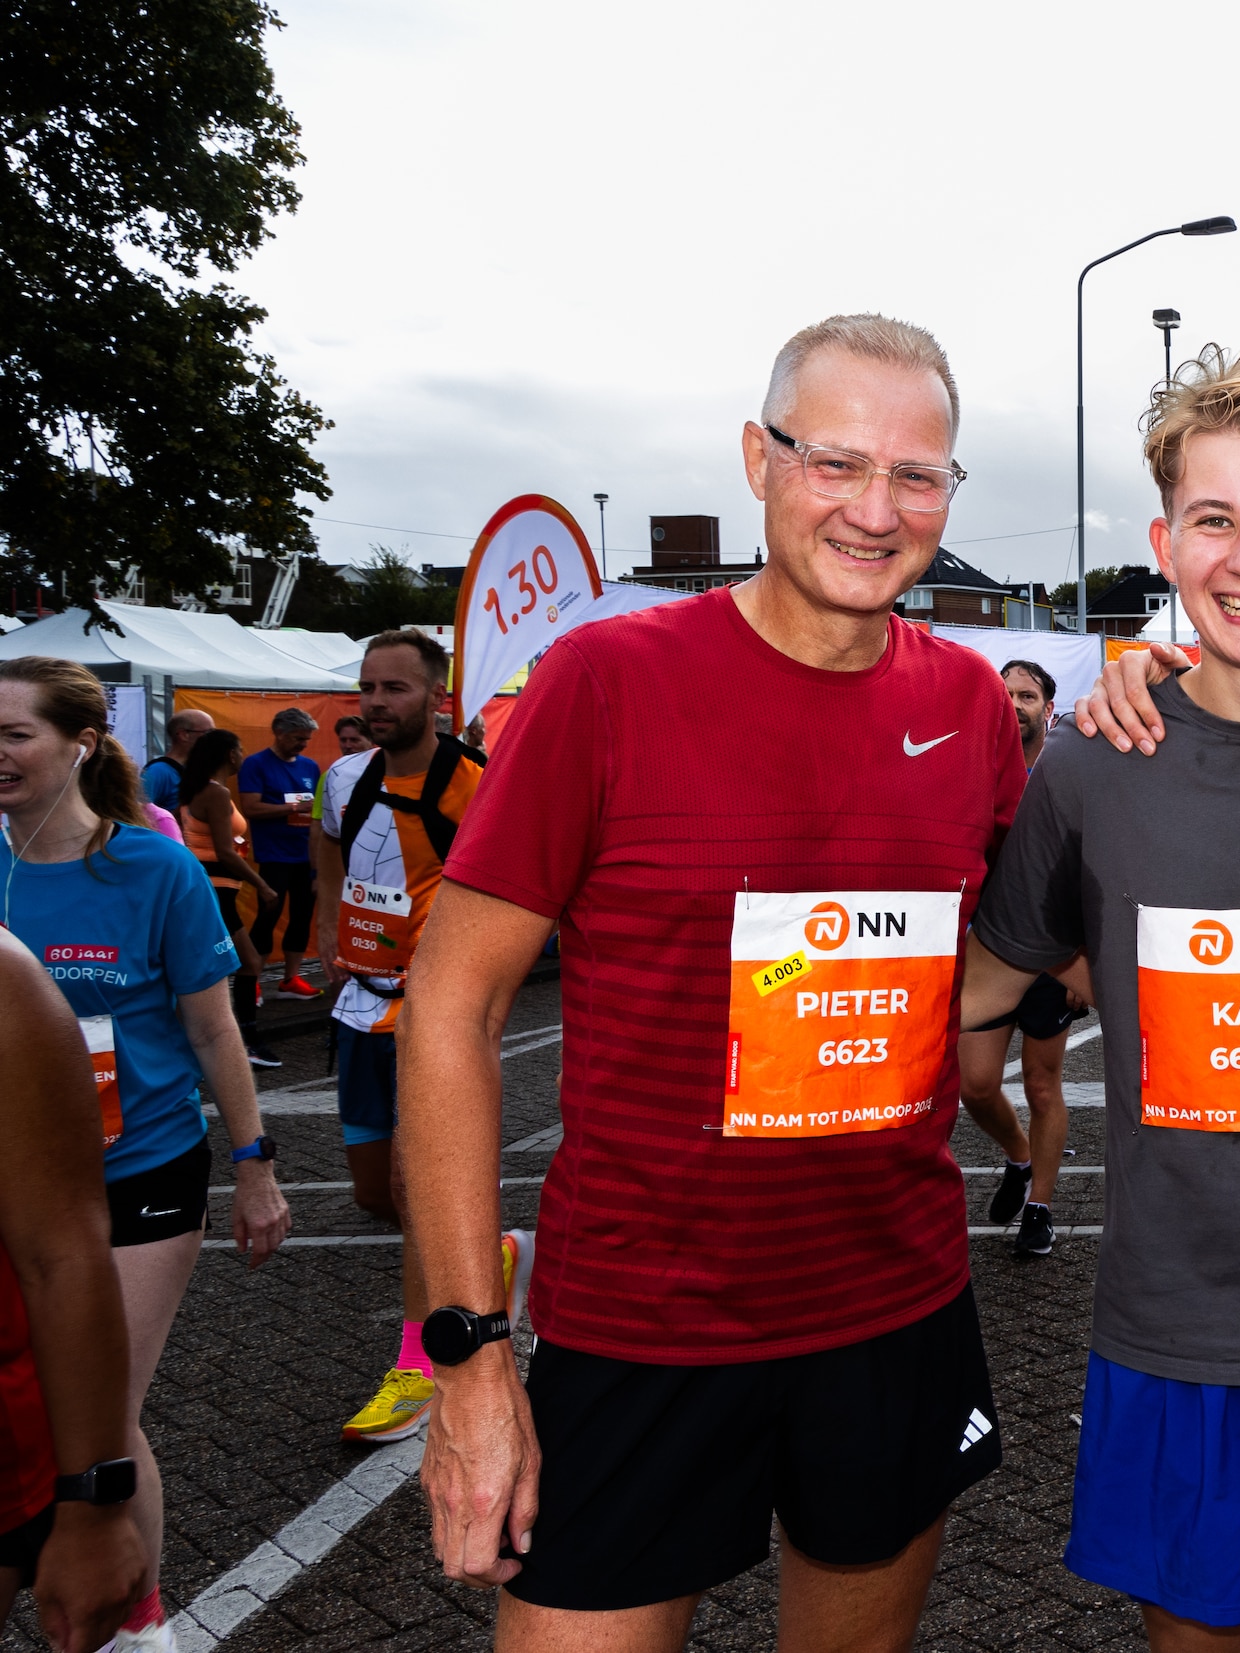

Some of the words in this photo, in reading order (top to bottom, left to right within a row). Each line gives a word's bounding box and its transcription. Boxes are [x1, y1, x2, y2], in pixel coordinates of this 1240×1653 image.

[484, 545, 558, 635] 1.30
[367, 891, 388, 905] NN
[348, 916, 385, 934] PACER
[857, 912, 906, 938] NN
[50, 947, 73, 960] 60
[77, 949, 115, 960] jaar
[352, 937, 377, 951] 01:30
[763, 957, 804, 987] 4.003
[796, 988, 909, 1018] PIETER
[818, 1038, 889, 1067] 6623
[94, 1070, 116, 1083] EN
[730, 1112, 757, 1127] NN
[761, 1113, 803, 1128] DAM
[807, 1111, 838, 1125] TOT
[842, 1103, 912, 1123] DAMLOOP
[1145, 1103, 1166, 1118] NN
[1169, 1107, 1201, 1121] DAM
[1205, 1110, 1237, 1123] TOT
